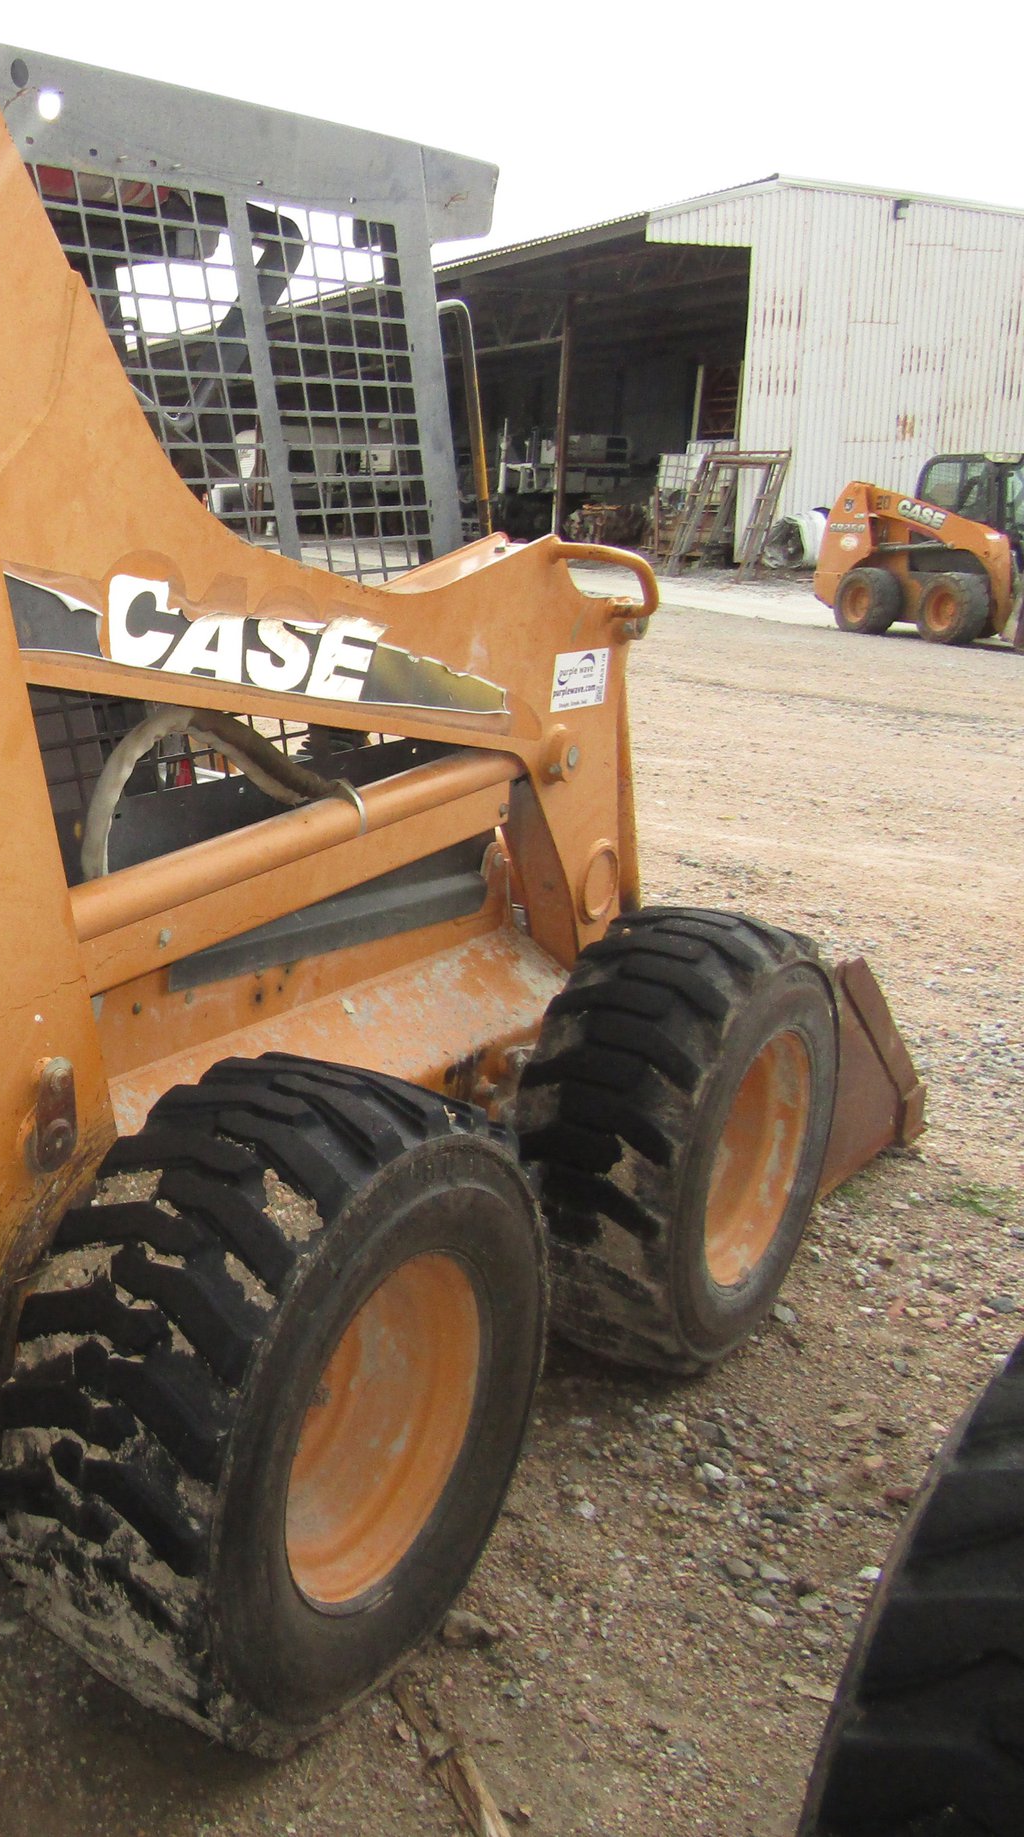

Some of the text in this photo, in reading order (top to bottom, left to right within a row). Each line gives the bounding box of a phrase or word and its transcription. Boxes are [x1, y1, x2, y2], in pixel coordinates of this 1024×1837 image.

[897, 499, 946, 530] CASE
[107, 572, 390, 703] CASE
[559, 667, 578, 677] purple
[579, 666, 594, 674] wave
[553, 685, 596, 698] purplewave.com
